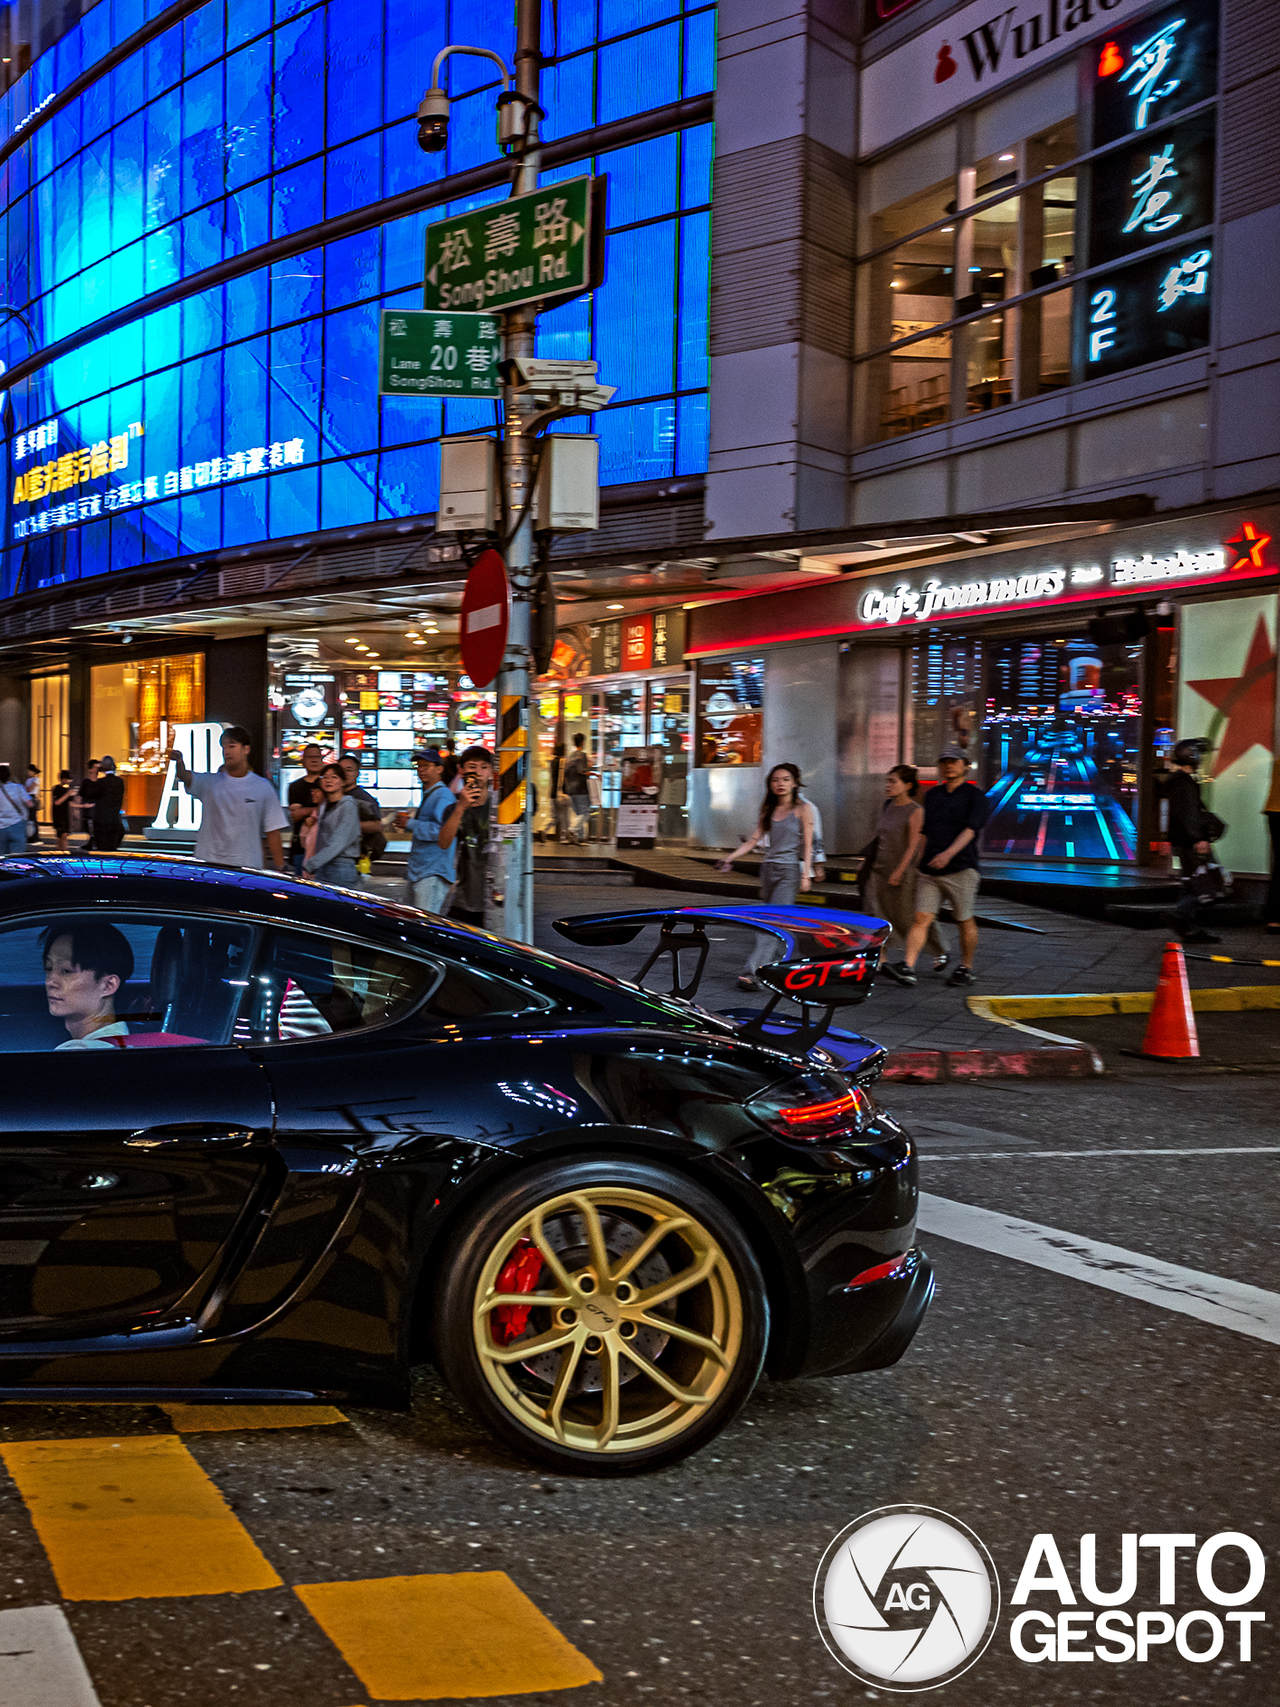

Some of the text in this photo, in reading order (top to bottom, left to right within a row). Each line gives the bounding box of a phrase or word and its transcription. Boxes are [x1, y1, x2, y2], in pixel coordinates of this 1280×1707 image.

[438, 198, 572, 274] 松壽路
[438, 250, 571, 310] SongShou Rd.
[390, 344, 492, 372] Lane 20 巷
[388, 374, 464, 391] SongShou
[784, 957, 868, 990] GT4
